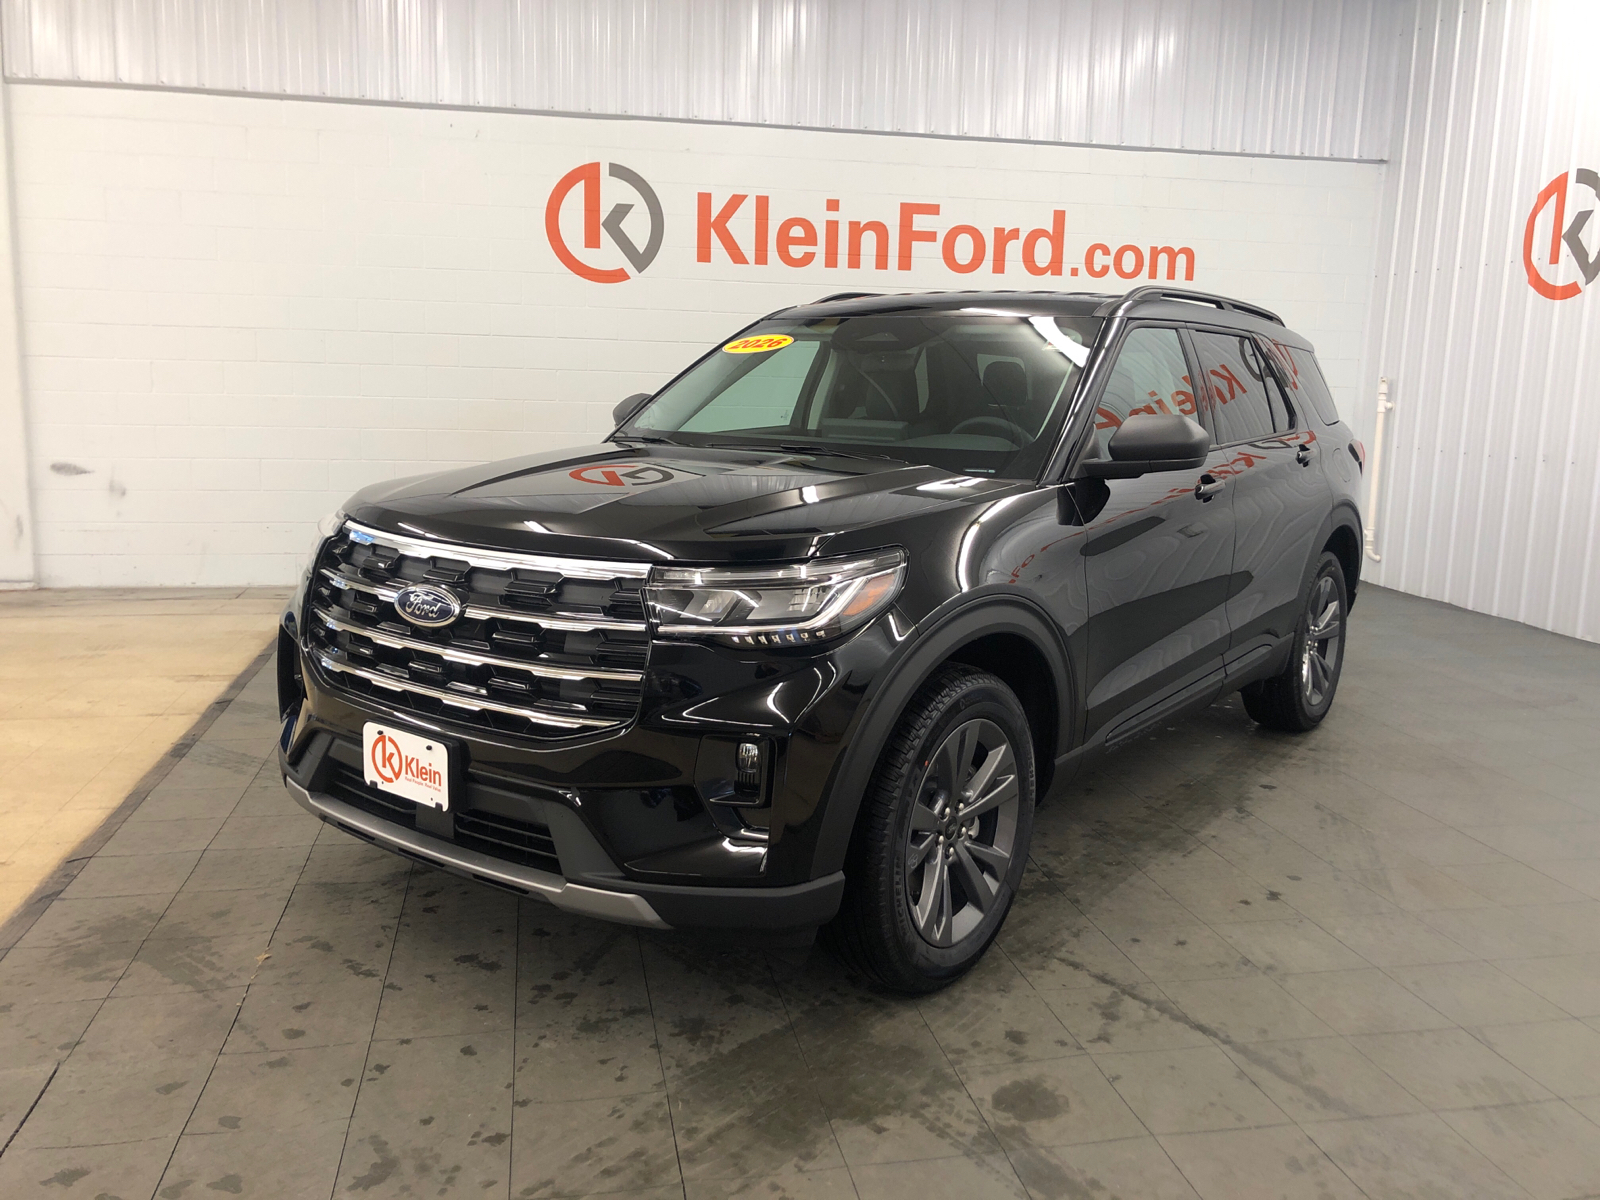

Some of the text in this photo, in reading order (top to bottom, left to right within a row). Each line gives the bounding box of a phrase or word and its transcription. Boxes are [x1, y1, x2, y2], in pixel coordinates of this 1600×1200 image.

[697, 192, 1196, 281] KleinFord.com
[728, 338, 788, 350] 2026
[405, 592, 441, 618] Ford
[405, 755, 441, 786] Klein
